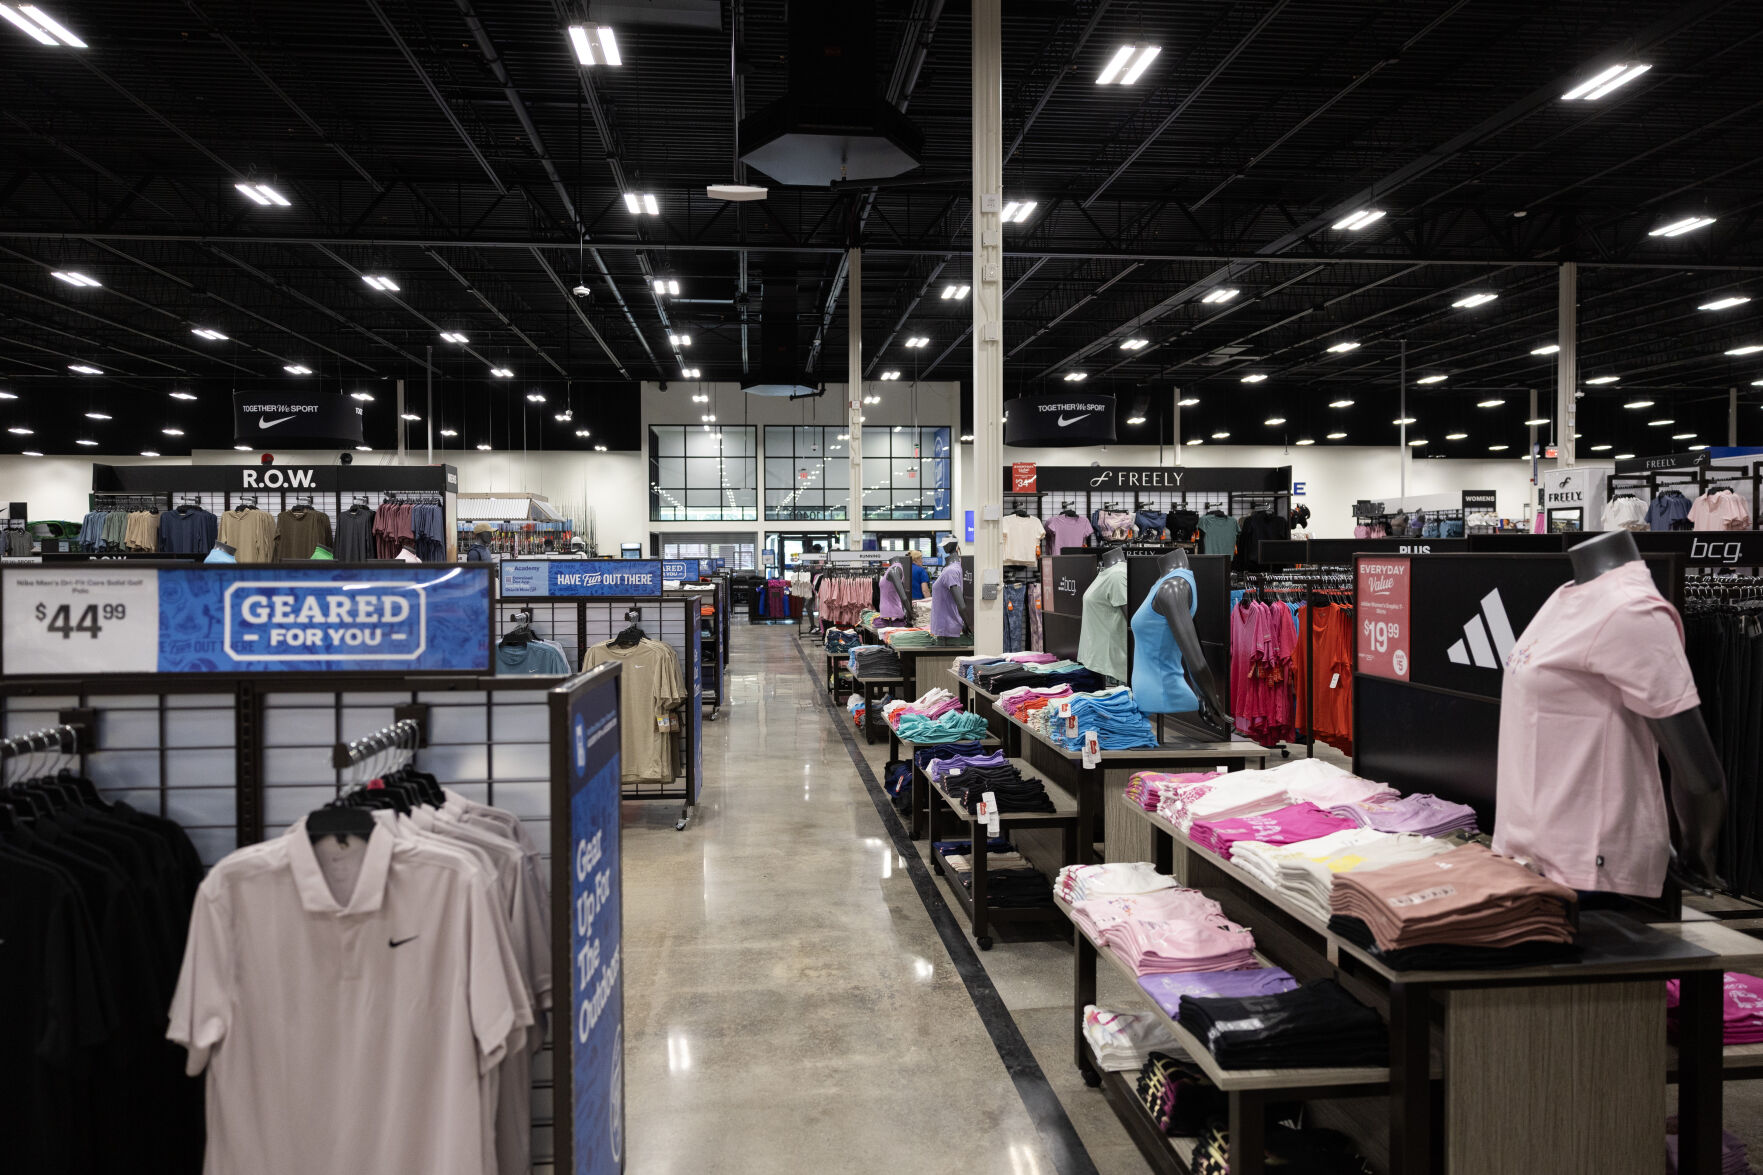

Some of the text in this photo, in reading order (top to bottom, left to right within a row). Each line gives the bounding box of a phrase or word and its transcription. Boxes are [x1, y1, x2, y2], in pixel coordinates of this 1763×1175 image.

[1038, 404, 1076, 412] TOGETHER
[1086, 404, 1105, 412] SPORT
[1646, 458, 1676, 468] FREELY
[243, 469, 316, 488] R.O.W.
[1118, 472, 1184, 486] FREELY
[1549, 490, 1583, 503] FREELY
[1690, 538, 1742, 563] bcg
[1360, 564, 1405, 574] EVERYDAY
[557, 572, 652, 587] HAVE Fun OUT THERE
[1368, 575, 1395, 592] Value
[241, 595, 410, 624] GEARED
[270, 628, 382, 646] FOR YOU
[576, 828, 602, 882] Gear
[577, 868, 610, 938] Up For
[577, 938, 600, 991] The
[579, 943, 620, 1044] Outdoors
